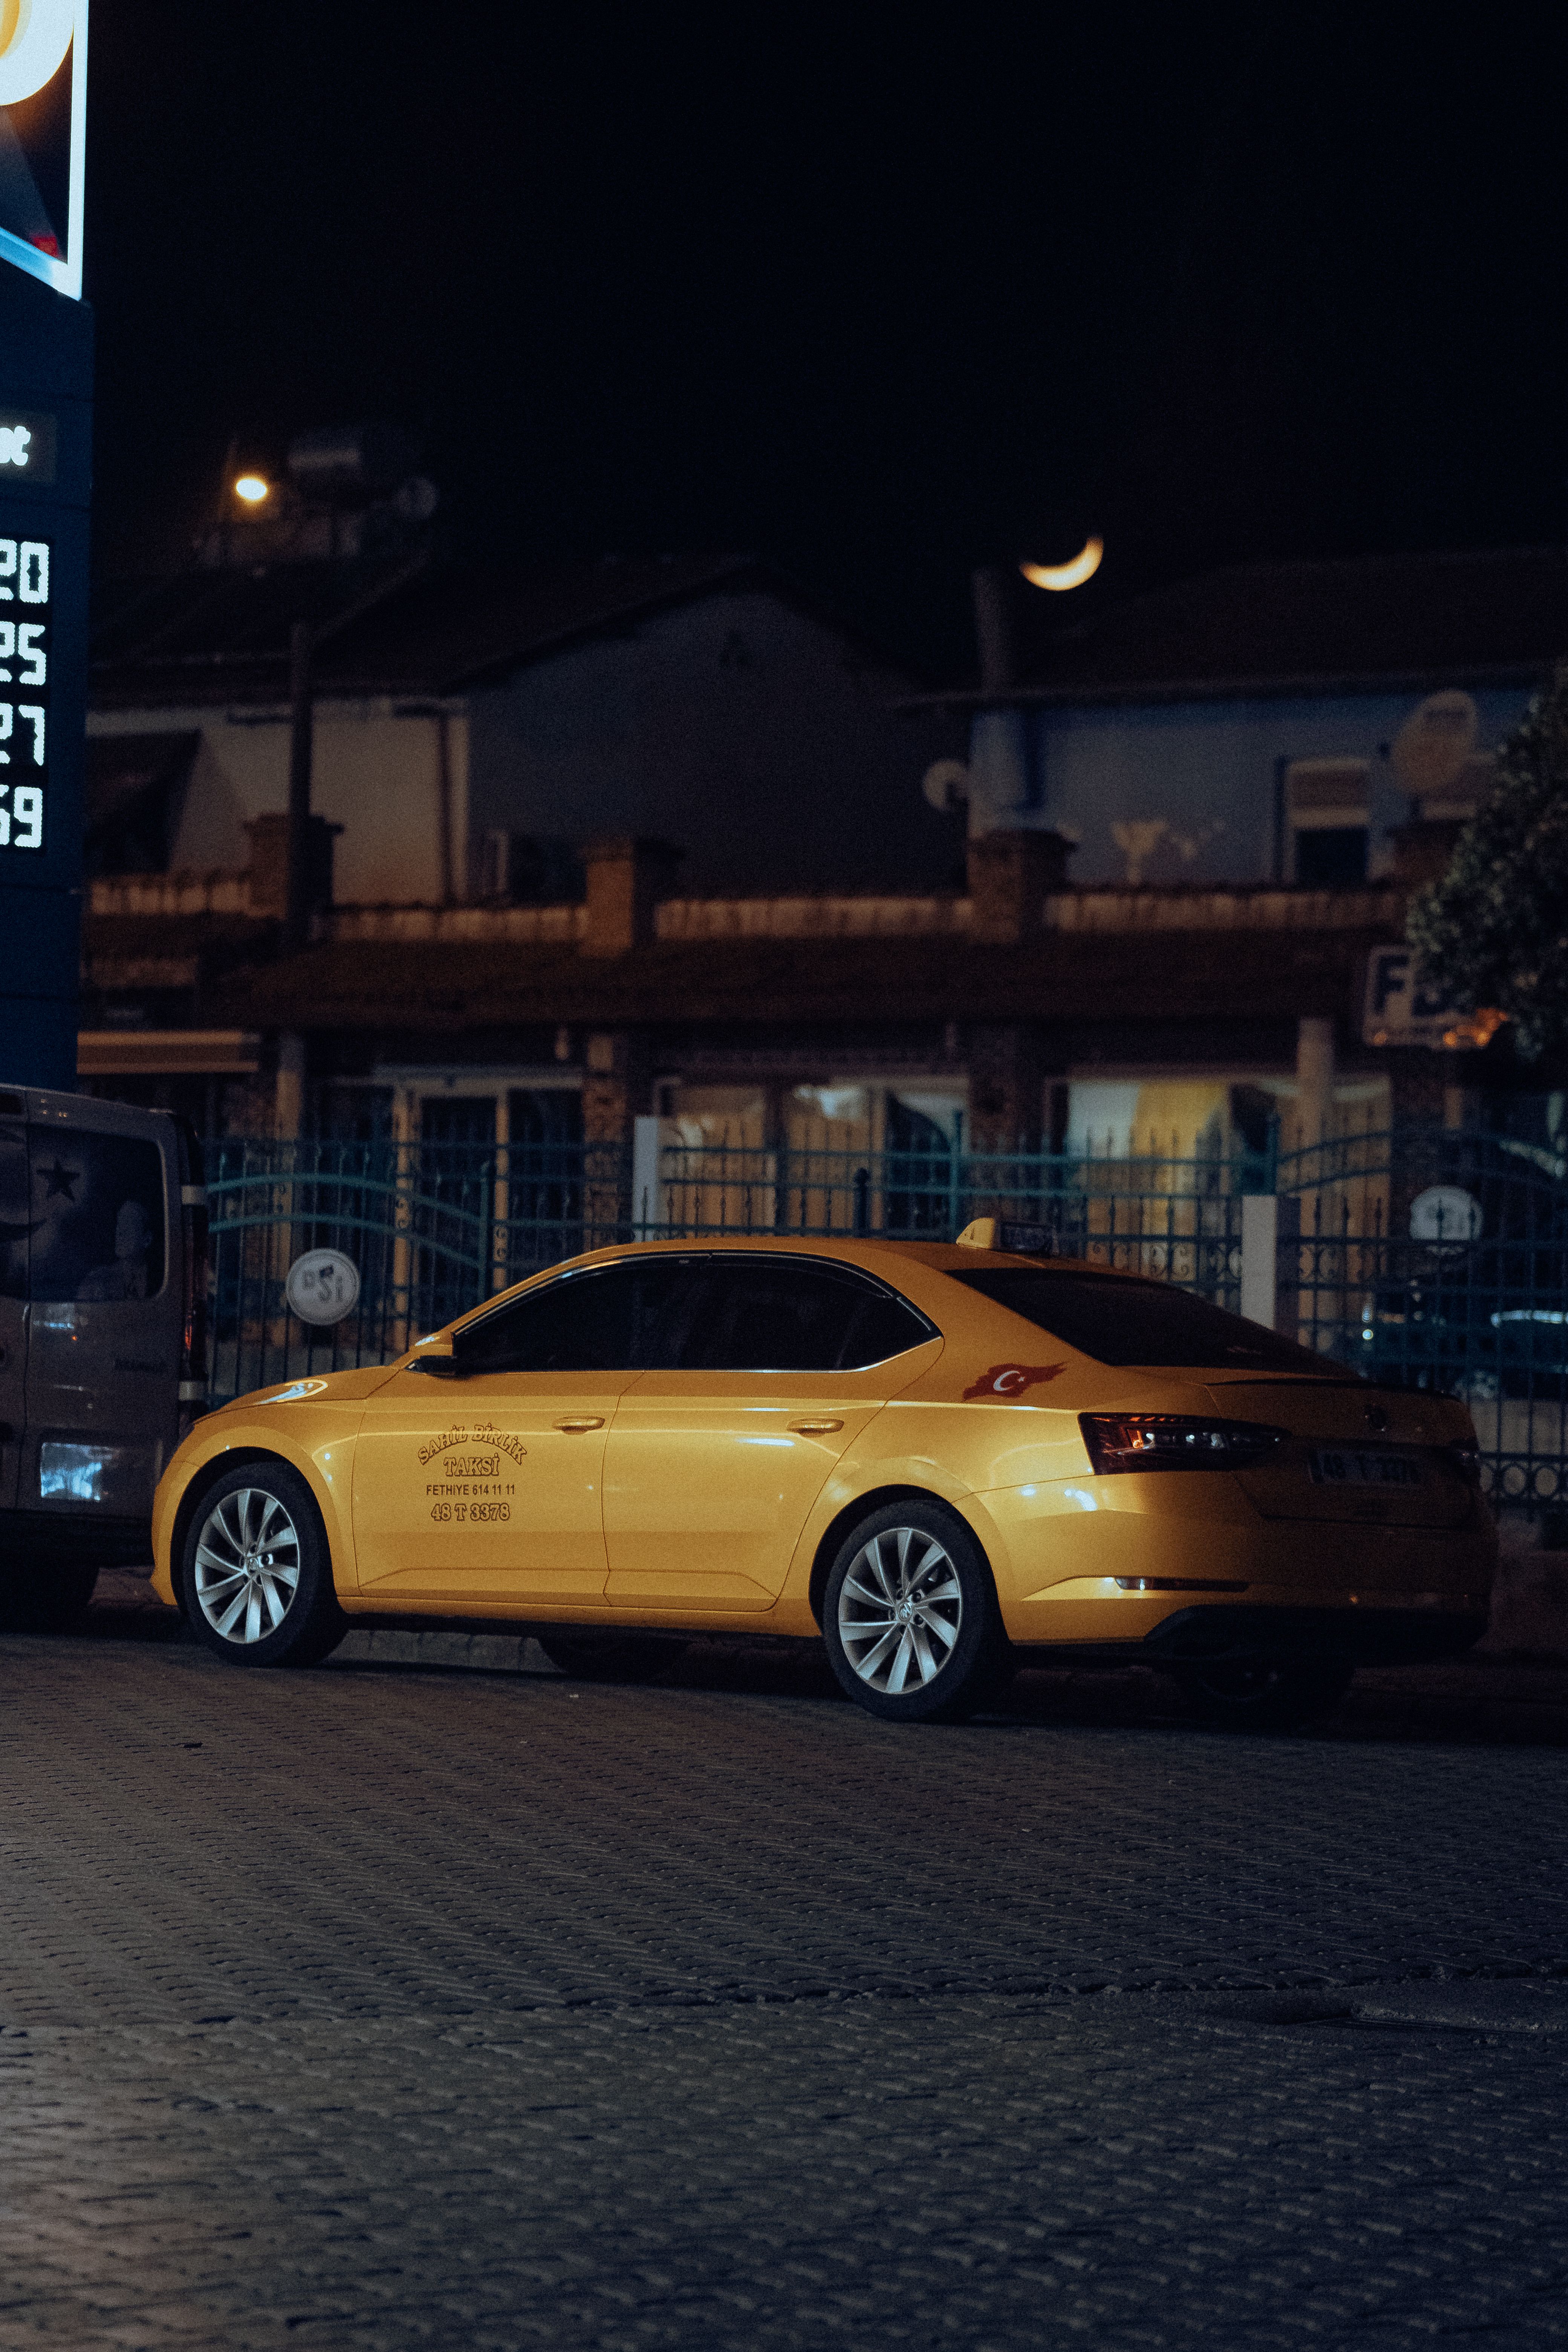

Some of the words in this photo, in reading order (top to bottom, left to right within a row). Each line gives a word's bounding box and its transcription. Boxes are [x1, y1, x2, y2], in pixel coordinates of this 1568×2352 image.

[418, 1425, 468, 1465] SAHİL
[472, 1423, 527, 1465] BİRLİK
[443, 1453, 499, 1476] TAKSİ
[472, 1484, 489, 1495] 614
[492, 1484, 501, 1495] 11
[505, 1484, 514, 1495] 11
[430, 1503, 452, 1521] 48
[454, 1503, 467, 1521] T
[470, 1502, 510, 1521] 3378
